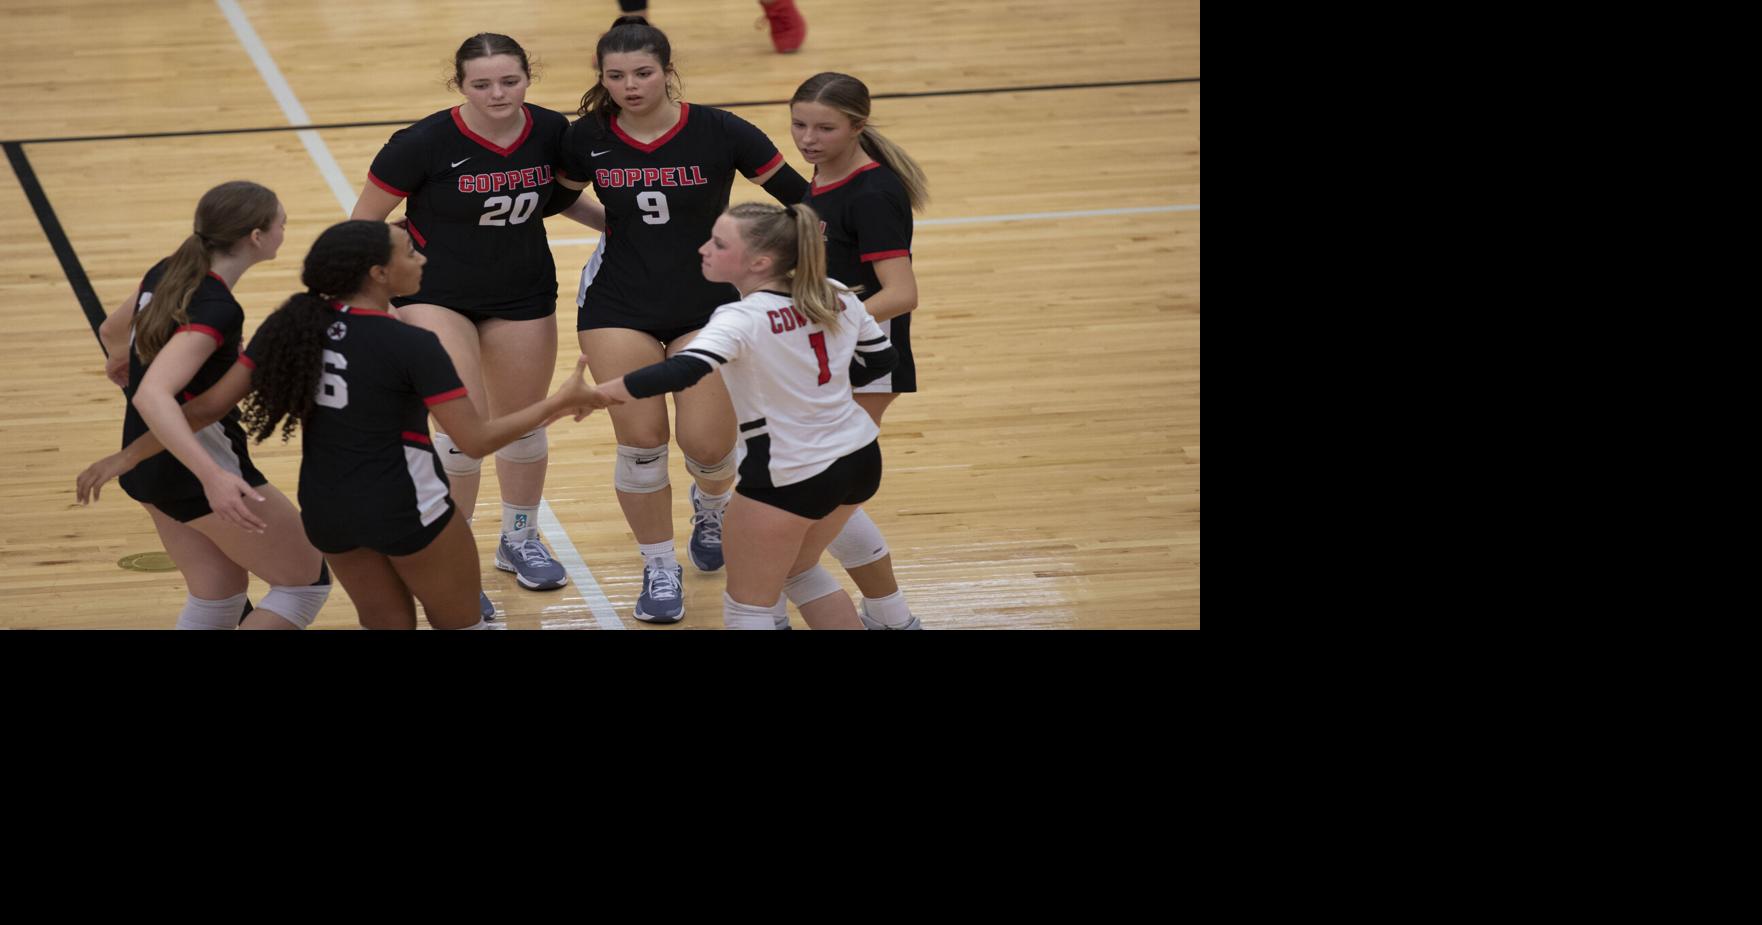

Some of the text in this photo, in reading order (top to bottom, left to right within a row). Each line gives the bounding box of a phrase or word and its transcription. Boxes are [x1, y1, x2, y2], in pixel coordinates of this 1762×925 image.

[458, 165, 554, 193] COPPELL
[596, 166, 707, 188] COPPELL
[478, 191, 539, 226] 20
[636, 191, 671, 225] 9
[808, 331, 832, 386] 1
[315, 349, 349, 410] 6
